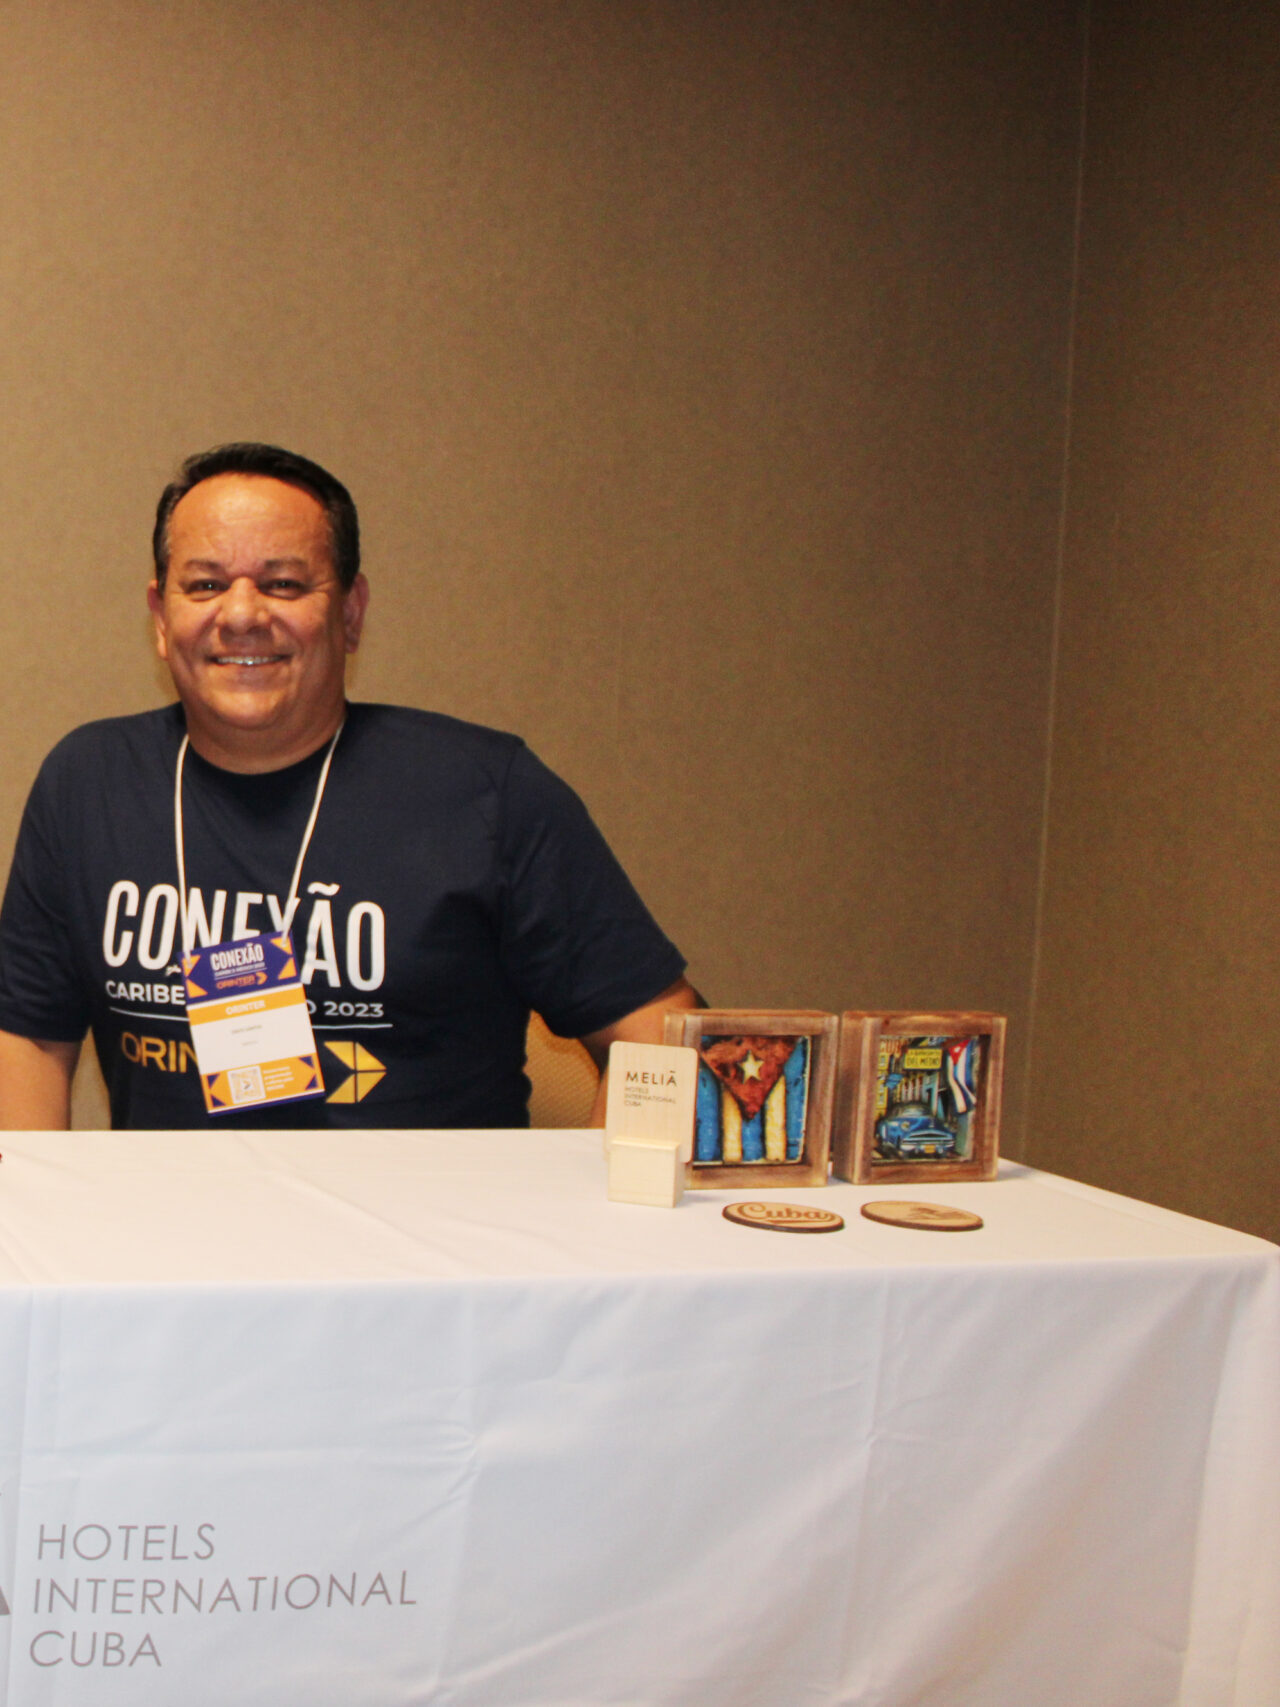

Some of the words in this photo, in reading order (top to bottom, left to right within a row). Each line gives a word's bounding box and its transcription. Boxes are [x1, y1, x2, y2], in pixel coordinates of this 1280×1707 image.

[210, 942, 265, 971] CONEXÃO
[323, 1001, 385, 1018] 2023
[625, 1070, 678, 1087] MELIÃ
[737, 1202, 835, 1222] Cuba
[37, 1522, 216, 1562] HOTELS
[31, 1568, 418, 1615] INTERNATIONAL
[29, 1629, 163, 1667] CUBA
